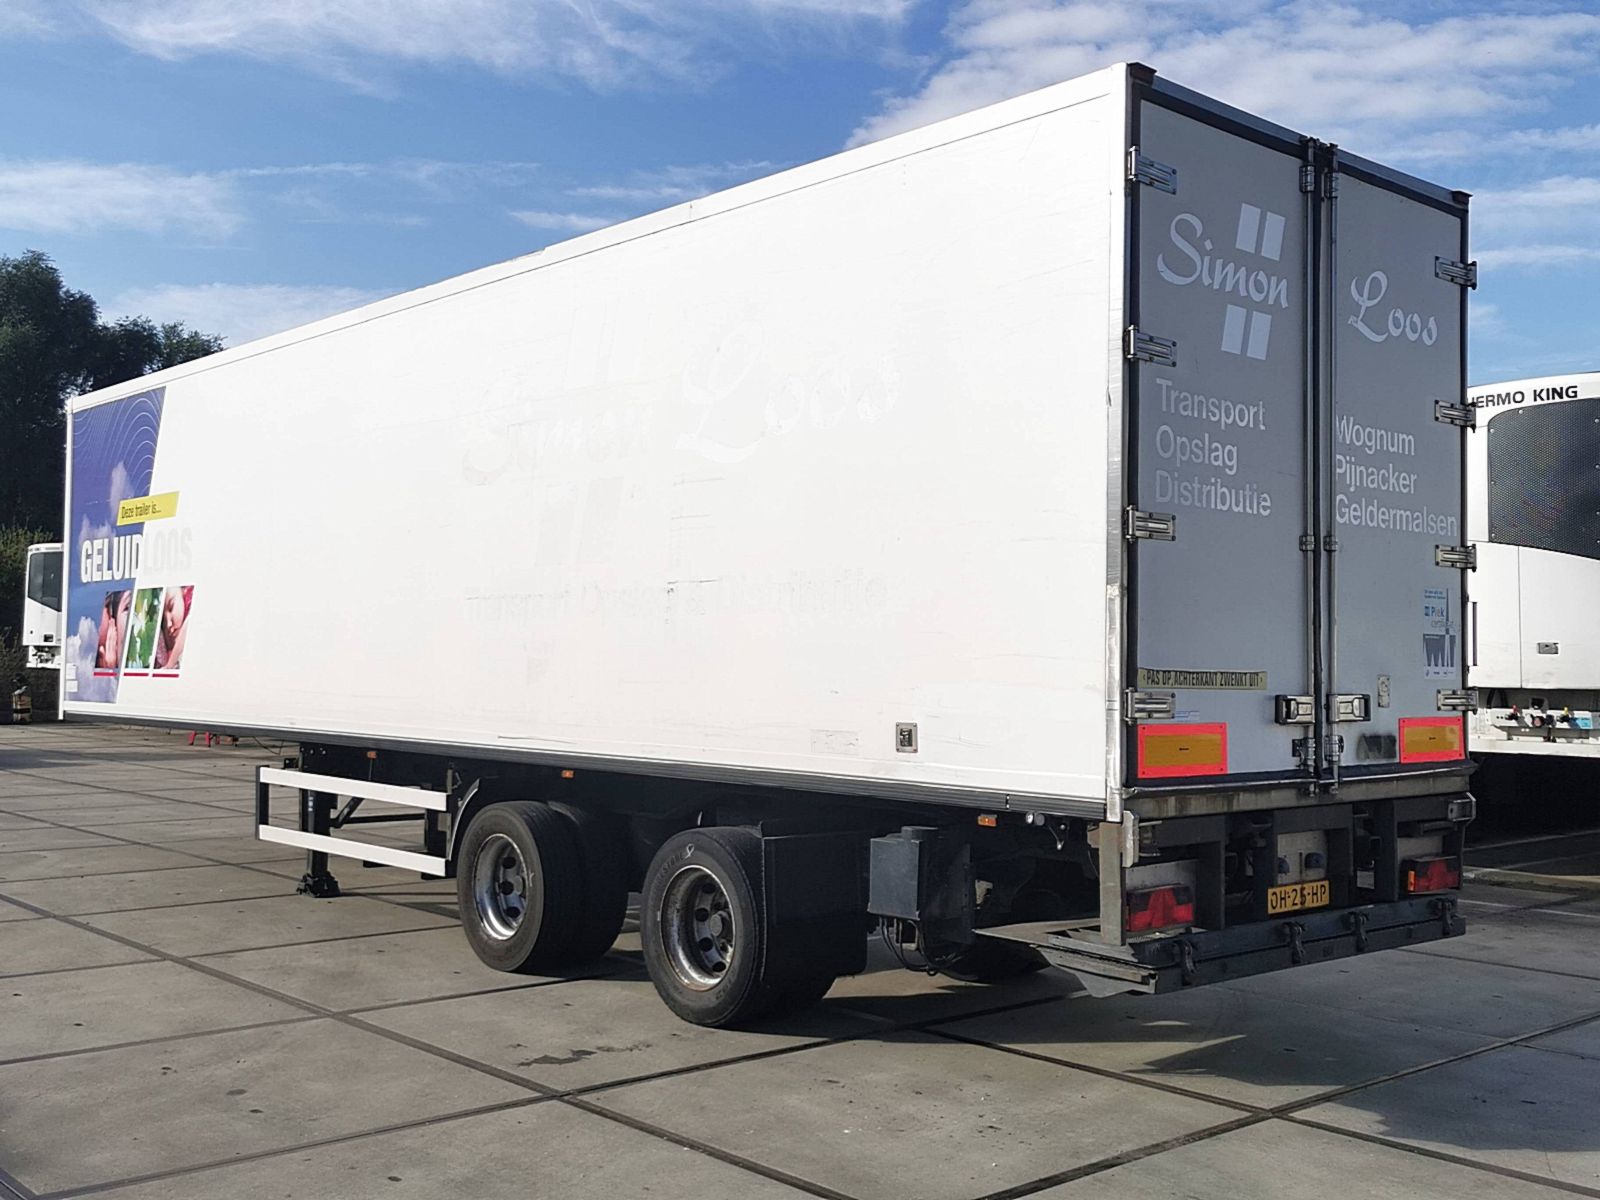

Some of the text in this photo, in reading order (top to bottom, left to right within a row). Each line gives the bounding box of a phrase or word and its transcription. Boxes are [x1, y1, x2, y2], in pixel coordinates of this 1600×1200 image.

[1157, 212, 1438, 346] Simon Loos
[1156, 377, 1266, 430] Transport
[1533, 385, 1578, 402] KING
[1156, 424, 1238, 475] Opslag
[1336, 415, 1415, 456] Wognum
[1155, 469, 1271, 516] Distributie
[1336, 454, 1417, 494] Pijnacker
[1336, 494, 1458, 537] Geldermalsen
[1146, 669, 1160, 686] PAS
[1220, 671, 1247, 687] ZWENKT
